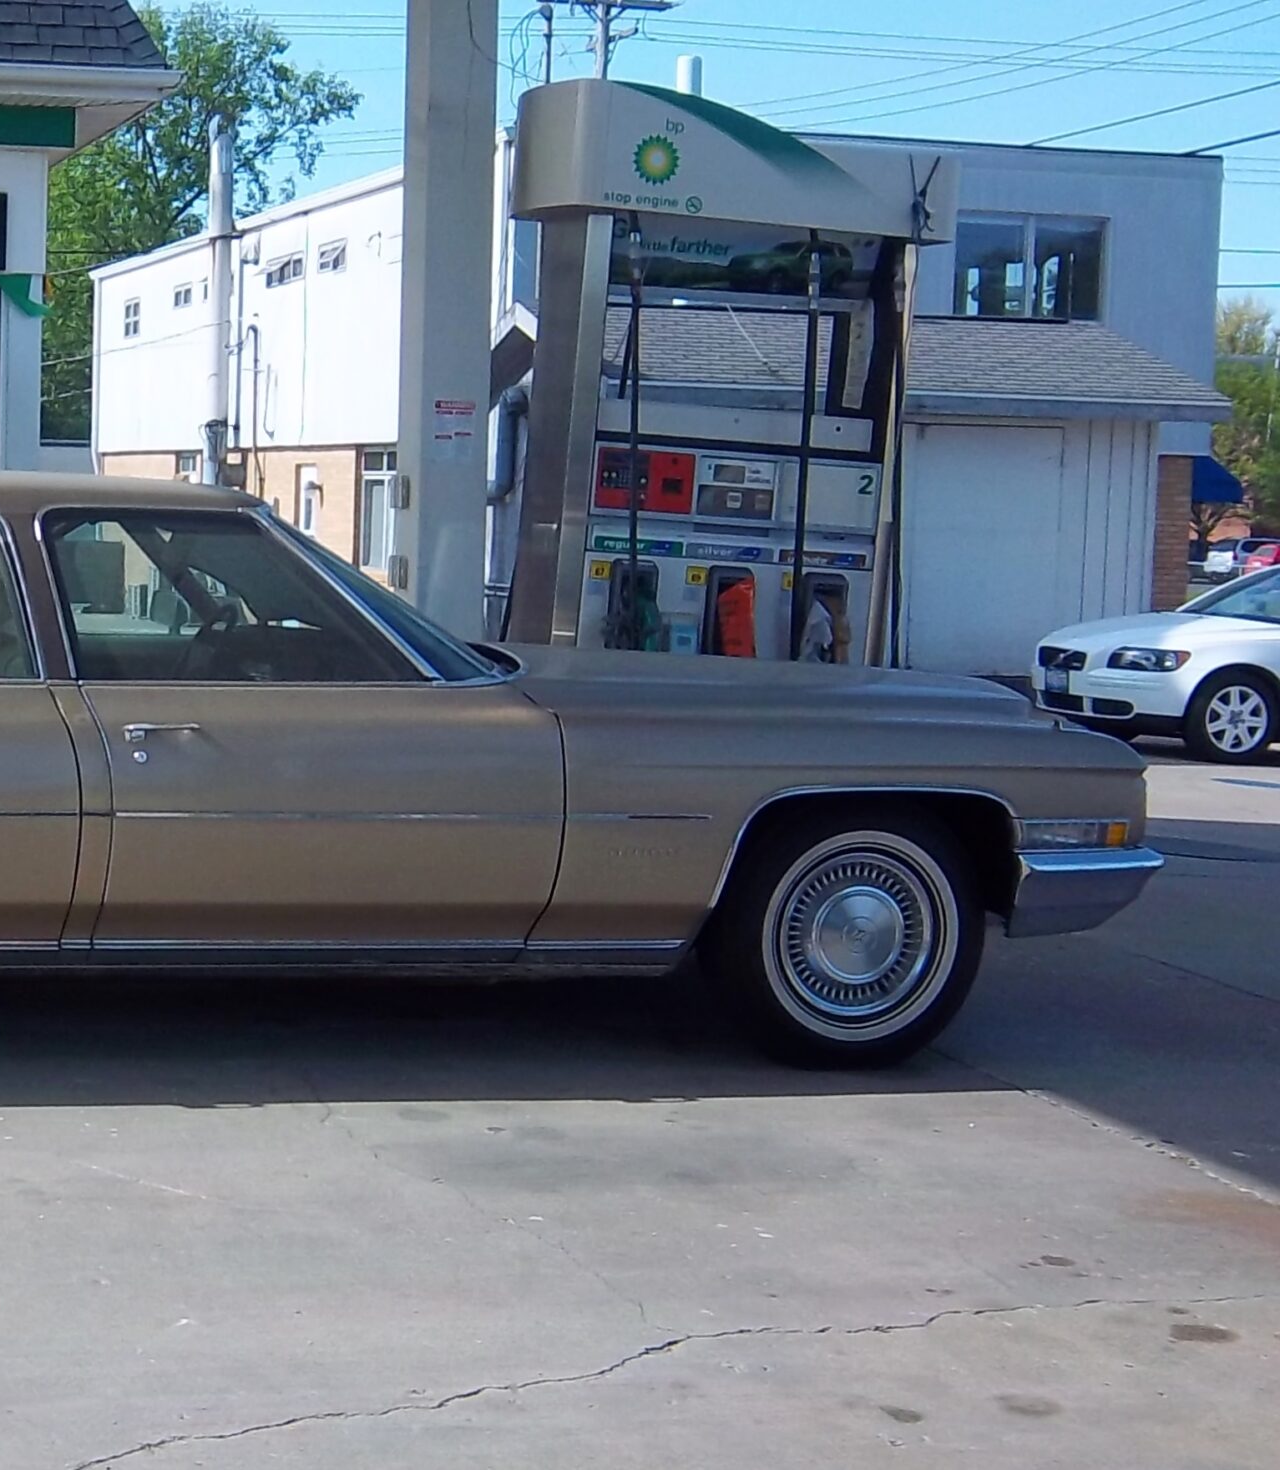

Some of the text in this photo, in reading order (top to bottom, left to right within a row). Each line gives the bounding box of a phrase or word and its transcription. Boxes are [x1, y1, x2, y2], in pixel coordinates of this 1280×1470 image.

[665, 117, 685, 135] bp
[604, 190, 679, 211] stop engine
[670, 235, 732, 257] farther
[857, 474, 875, 495] 2
[603, 540, 646, 550] reguar
[697, 547, 733, 555] silver
